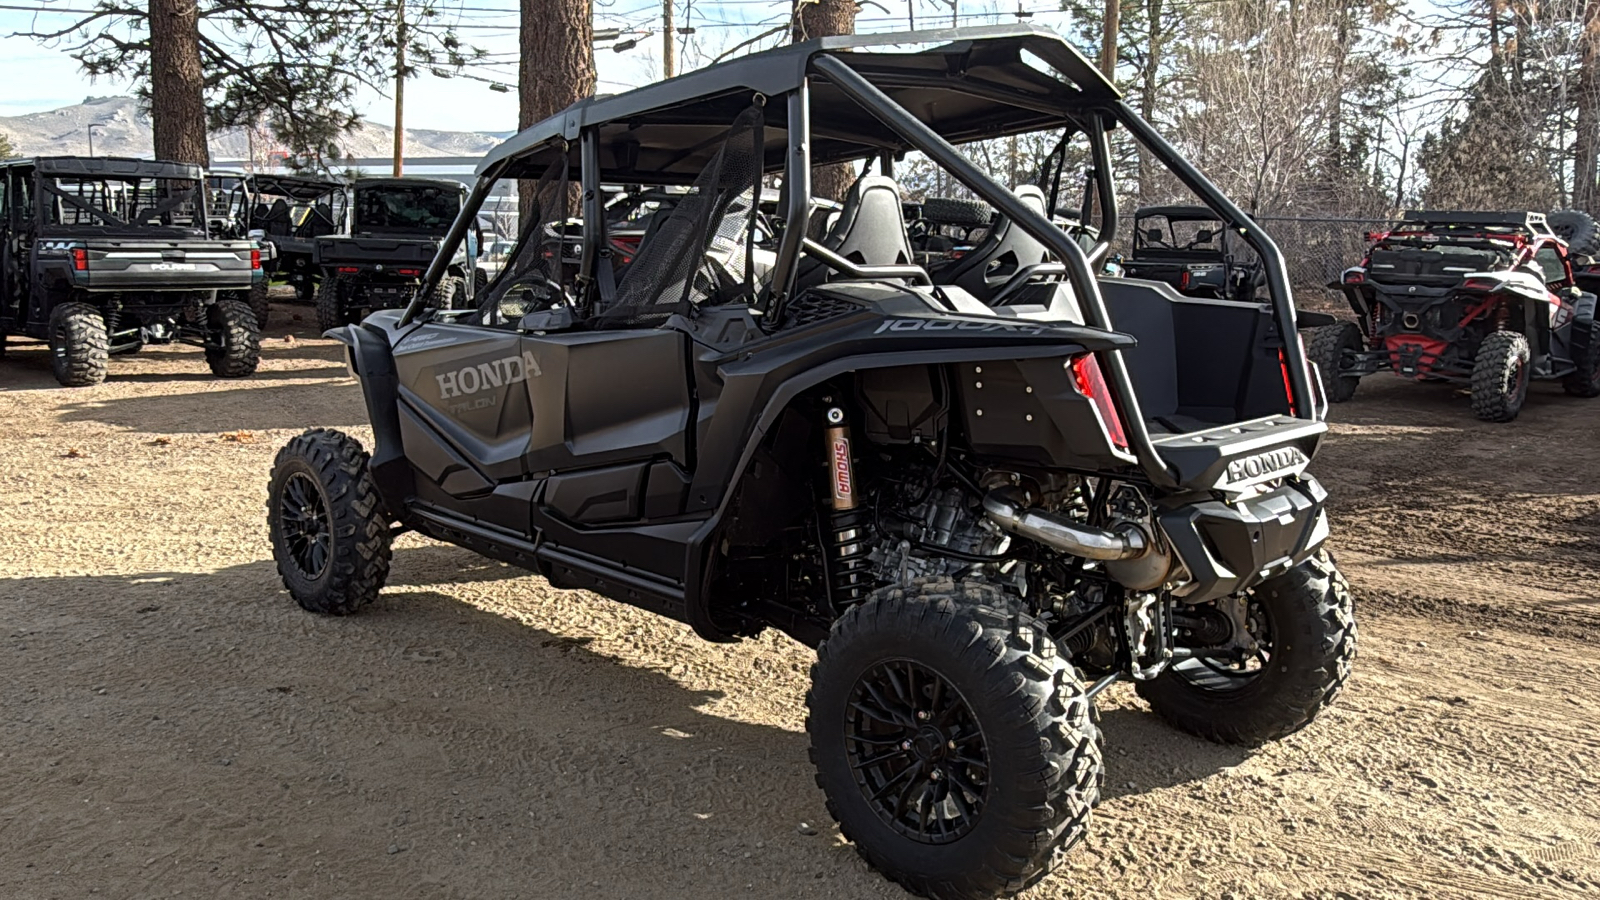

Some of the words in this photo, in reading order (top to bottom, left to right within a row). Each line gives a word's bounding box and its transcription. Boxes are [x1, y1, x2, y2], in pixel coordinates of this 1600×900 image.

[435, 350, 542, 399] HONDA
[834, 441, 851, 495] SHOWA
[1226, 446, 1304, 484] HONDA
